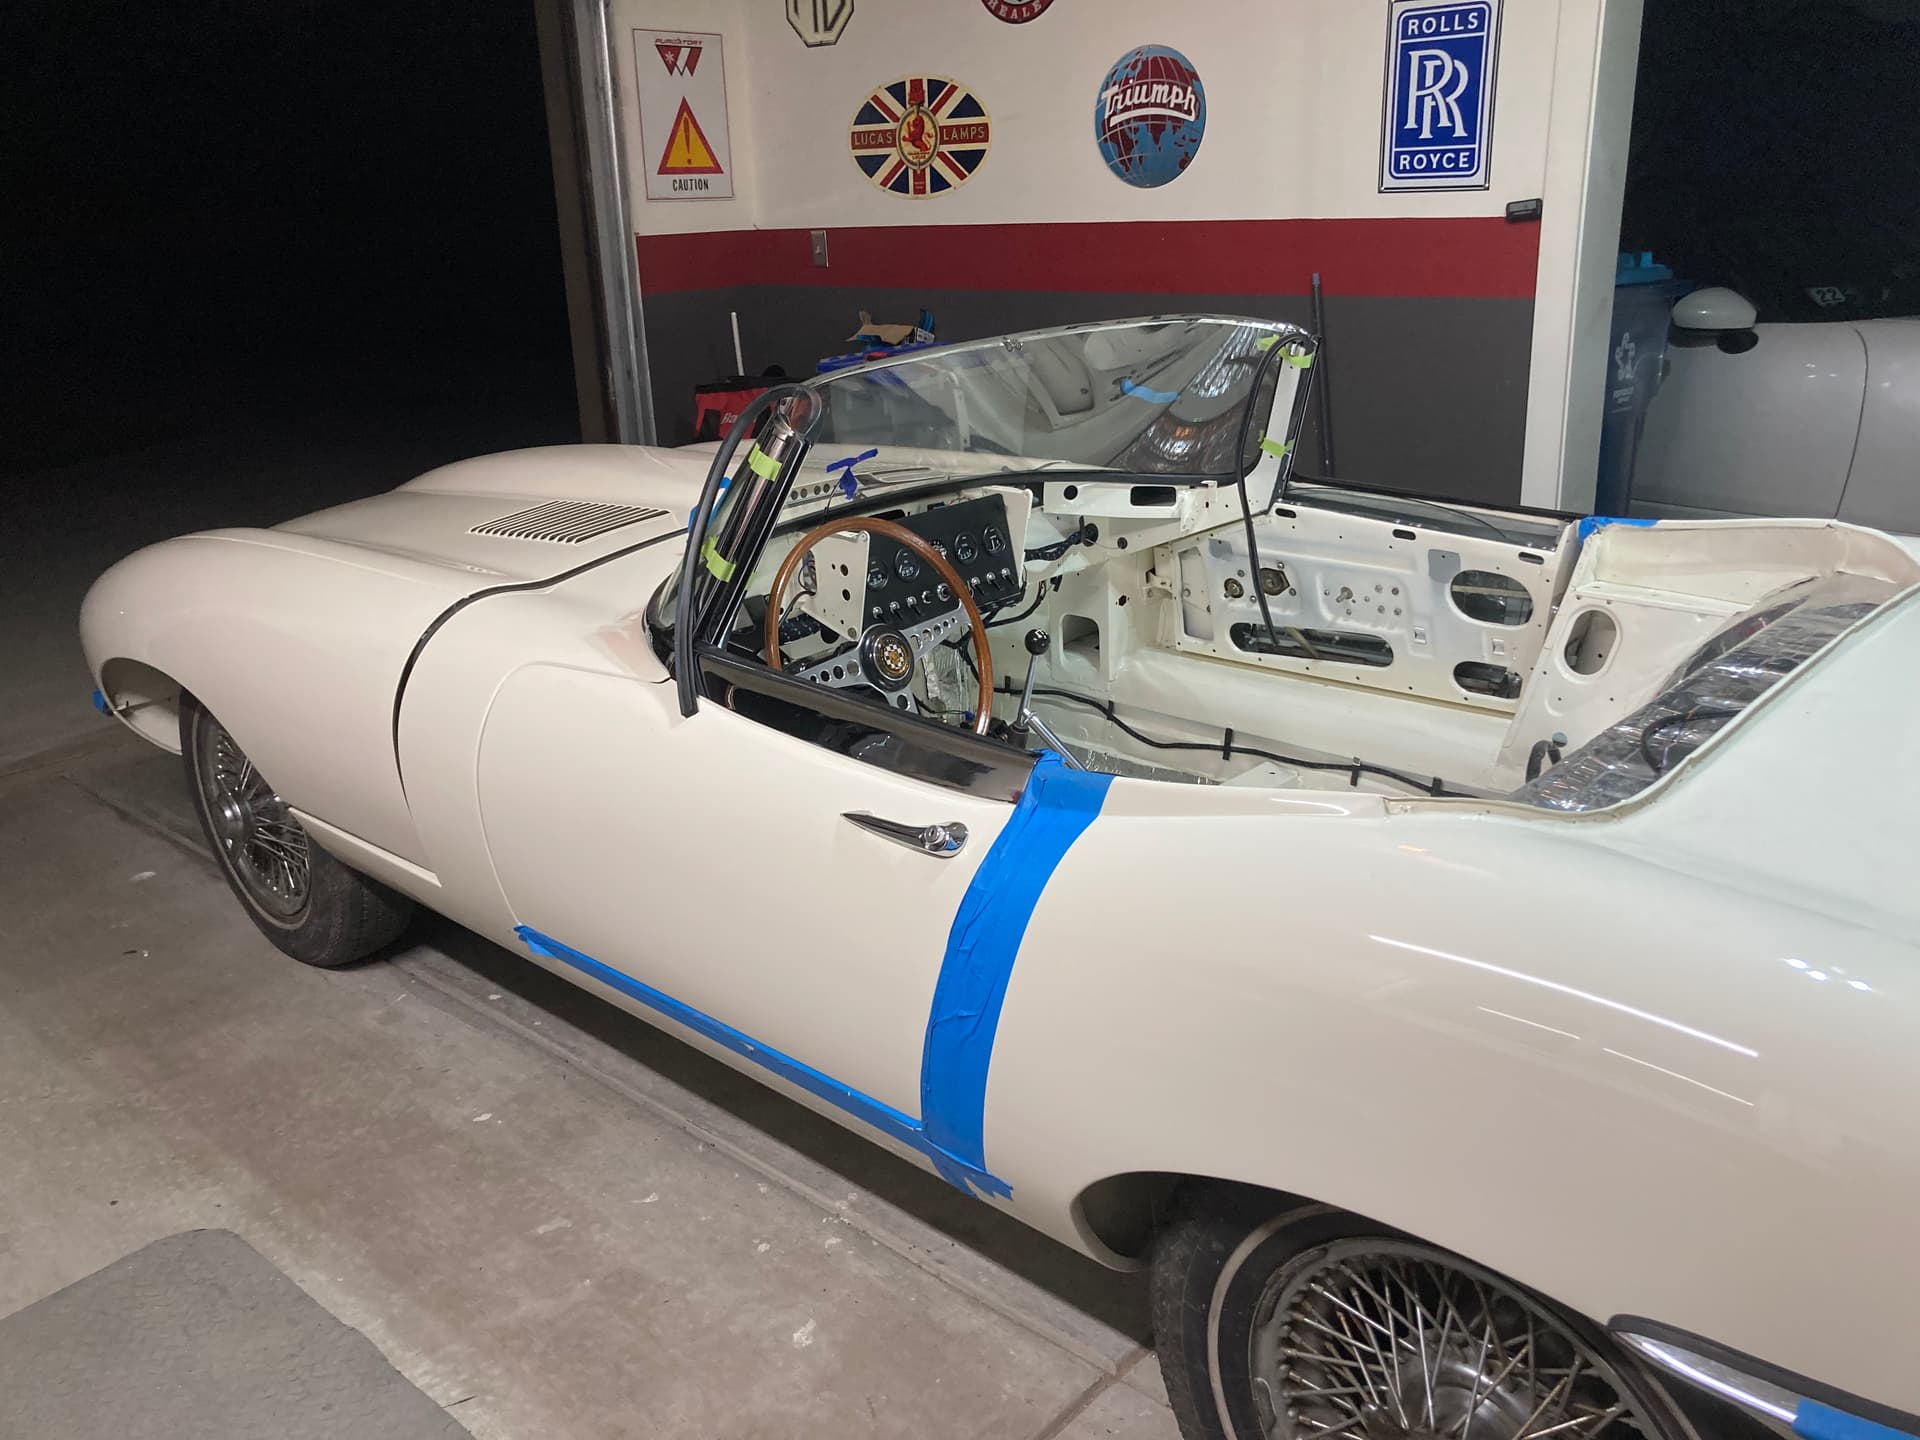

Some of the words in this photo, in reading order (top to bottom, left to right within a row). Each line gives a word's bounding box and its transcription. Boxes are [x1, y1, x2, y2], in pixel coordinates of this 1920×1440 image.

[988, 0, 1042, 19] HEALE
[1408, 12, 1478, 35] ROLLS
[1101, 78, 1195, 120] Triumph
[854, 132, 893, 146] LUCAS
[943, 126, 985, 141] LAMPS
[1399, 152, 1470, 170] ROYCE
[673, 178, 709, 191] CAUTION
